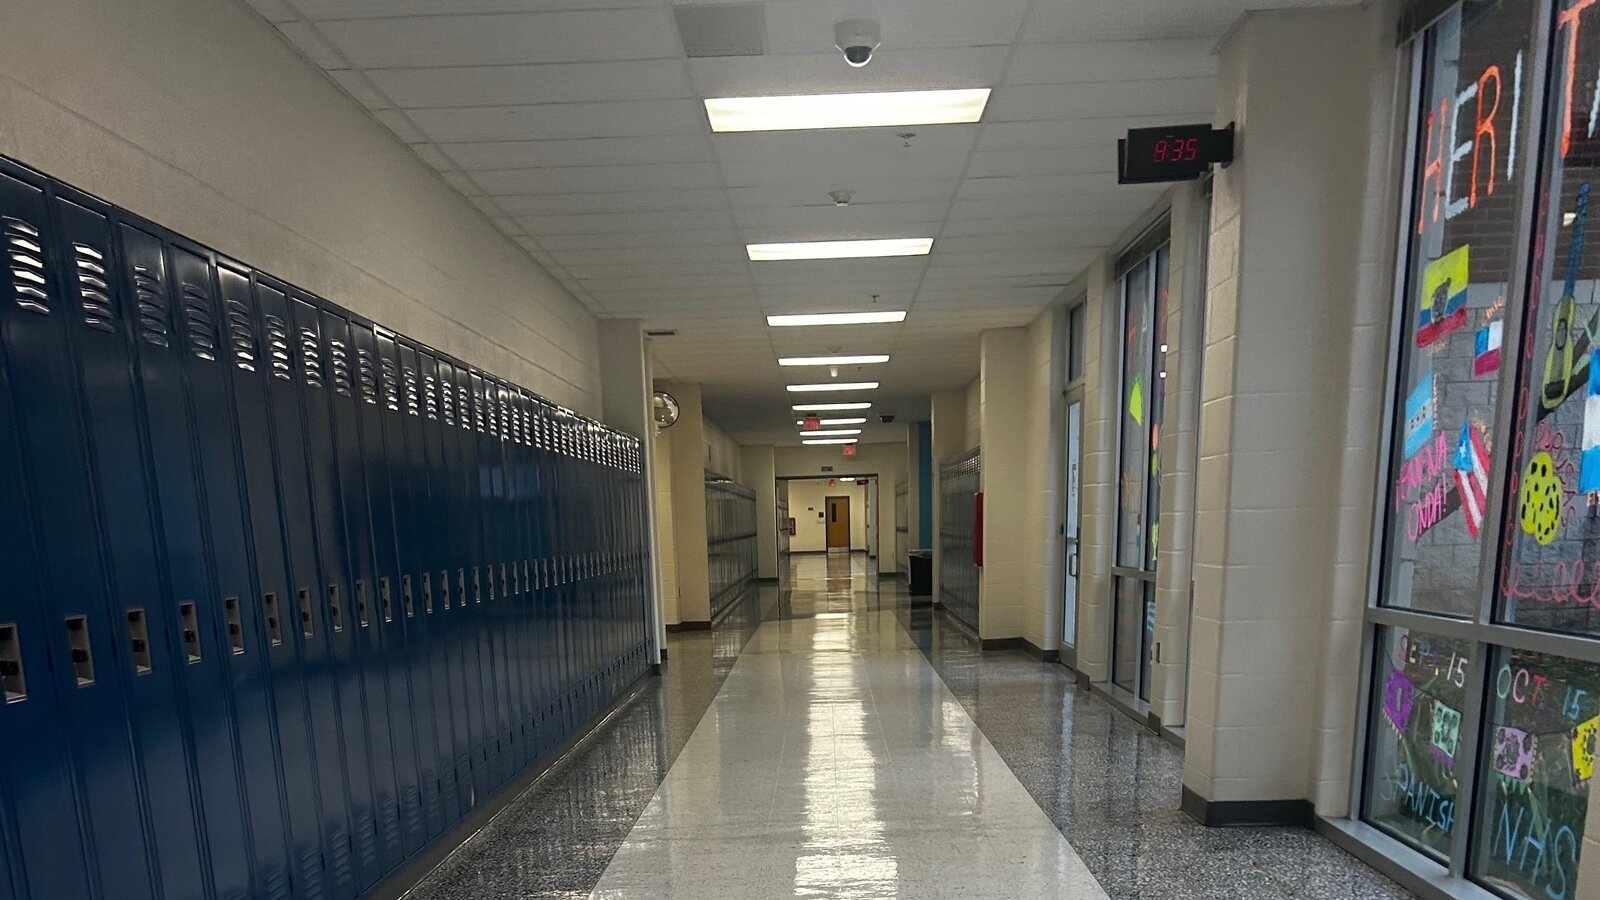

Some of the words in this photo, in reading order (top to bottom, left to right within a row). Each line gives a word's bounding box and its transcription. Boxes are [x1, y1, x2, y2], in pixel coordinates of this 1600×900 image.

[1446, 652, 1468, 688] 15
[1562, 686, 1587, 720] 15
[1493, 802, 1576, 900] NHS
